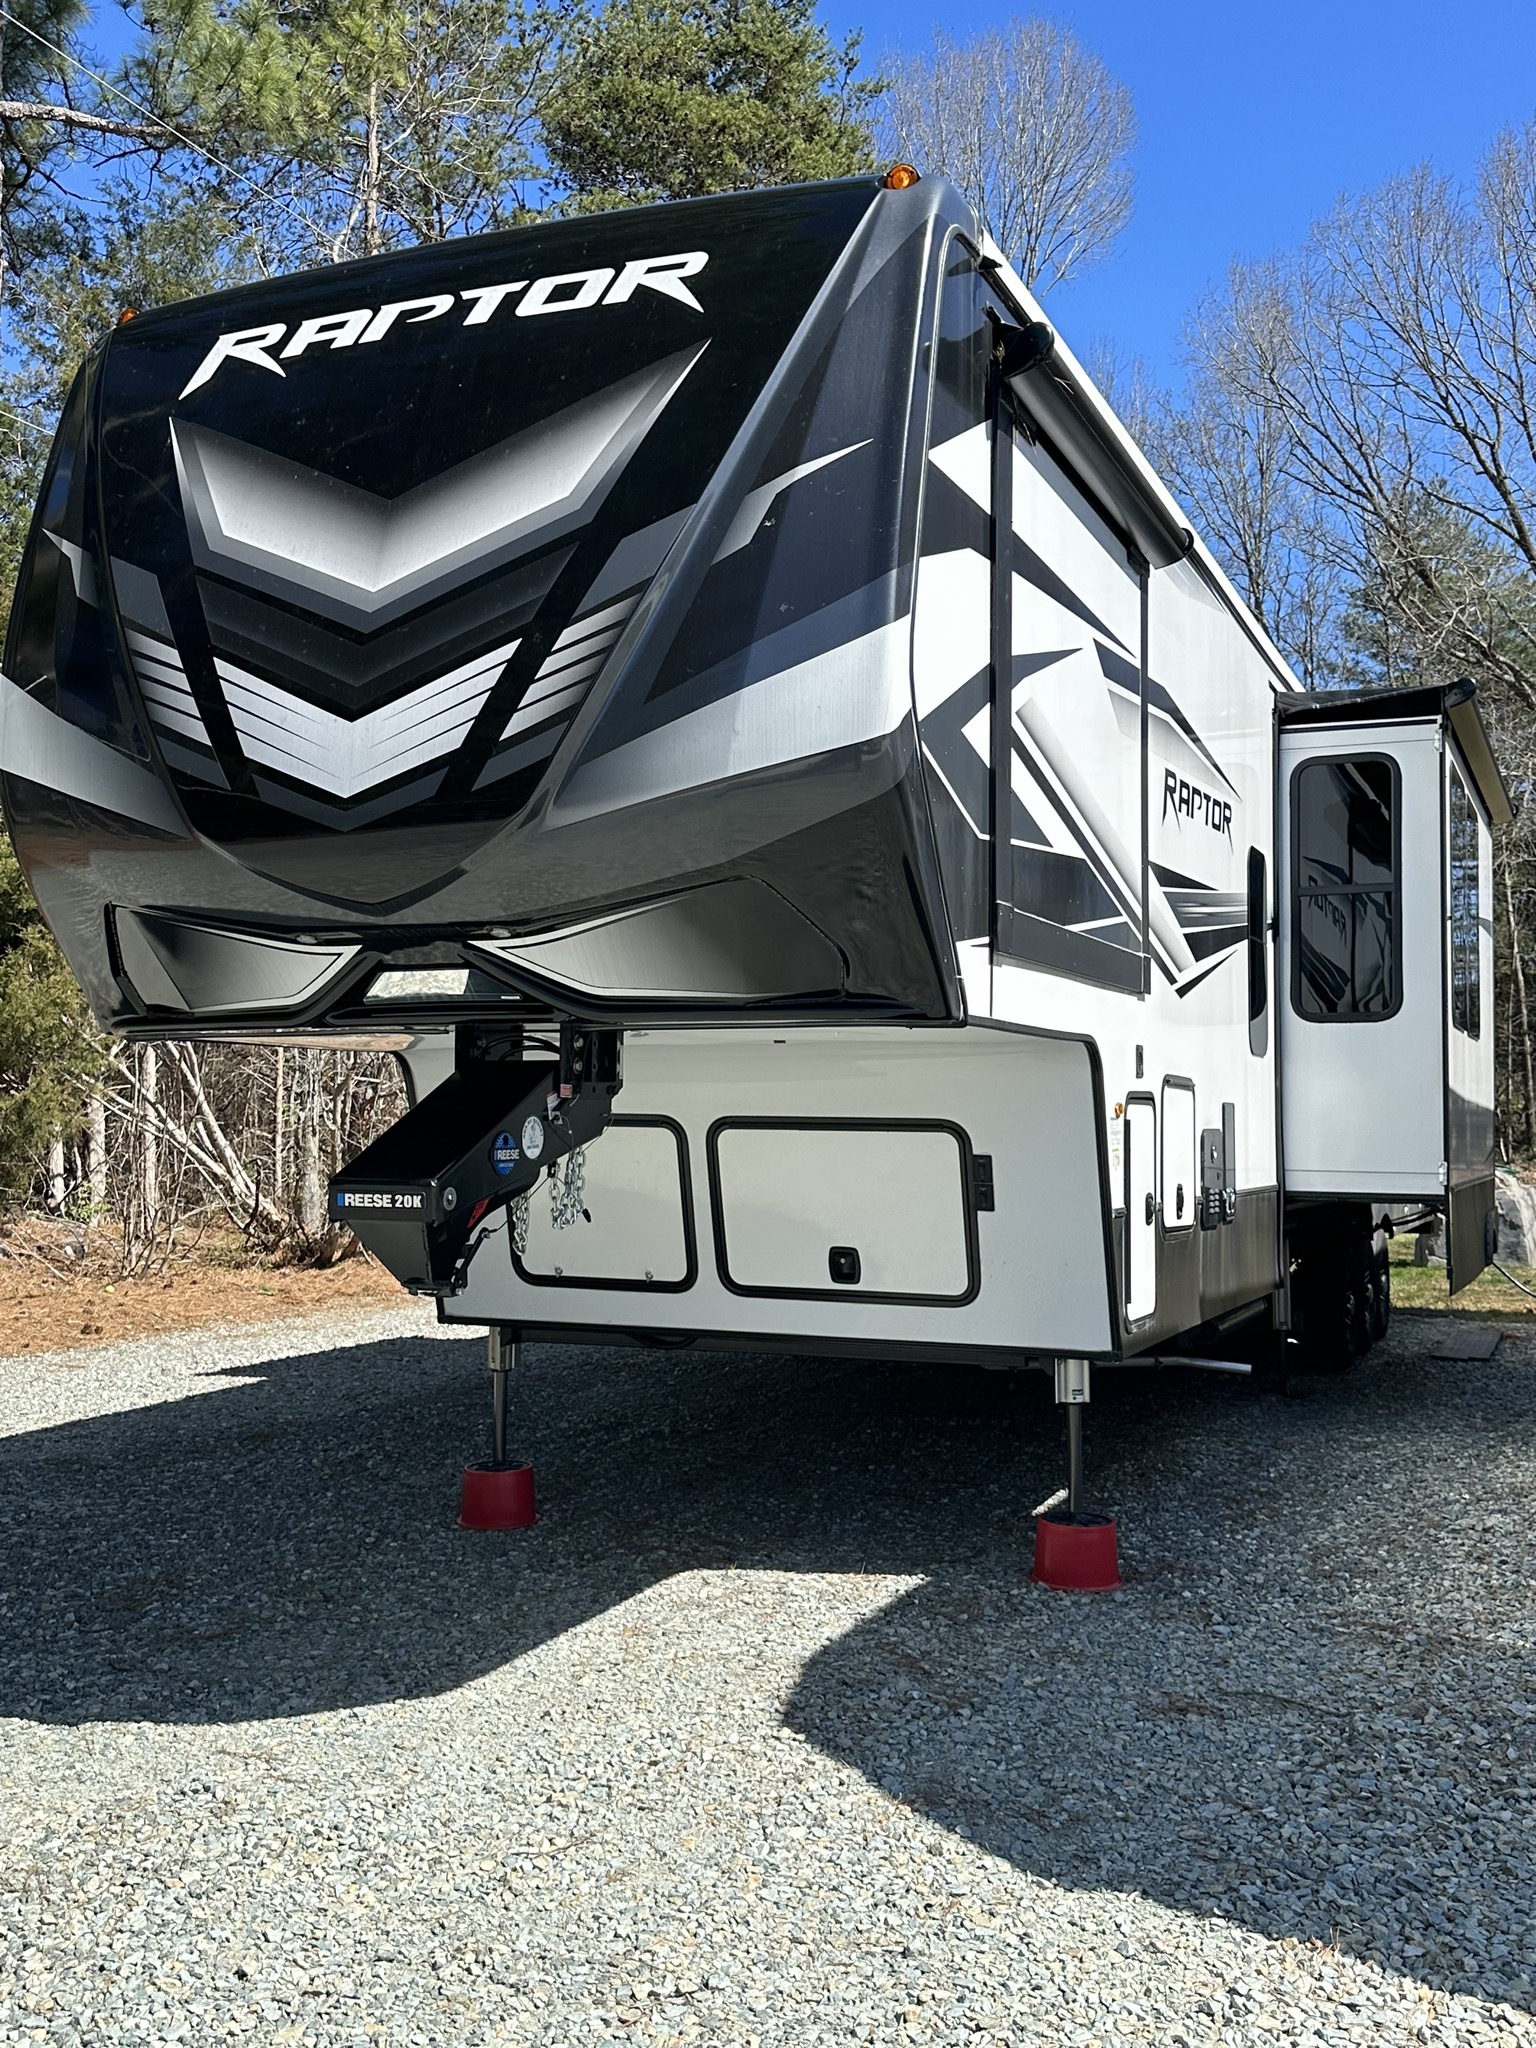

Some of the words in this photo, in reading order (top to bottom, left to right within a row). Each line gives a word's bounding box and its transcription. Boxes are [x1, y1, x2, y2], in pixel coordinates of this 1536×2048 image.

[178, 250, 710, 400] RAPTOR
[1162, 767, 1234, 856] RAPTOR
[498, 1149, 520, 1160] REESE
[344, 1193, 393, 1208] REESE
[394, 1194, 422, 1208] 20K
